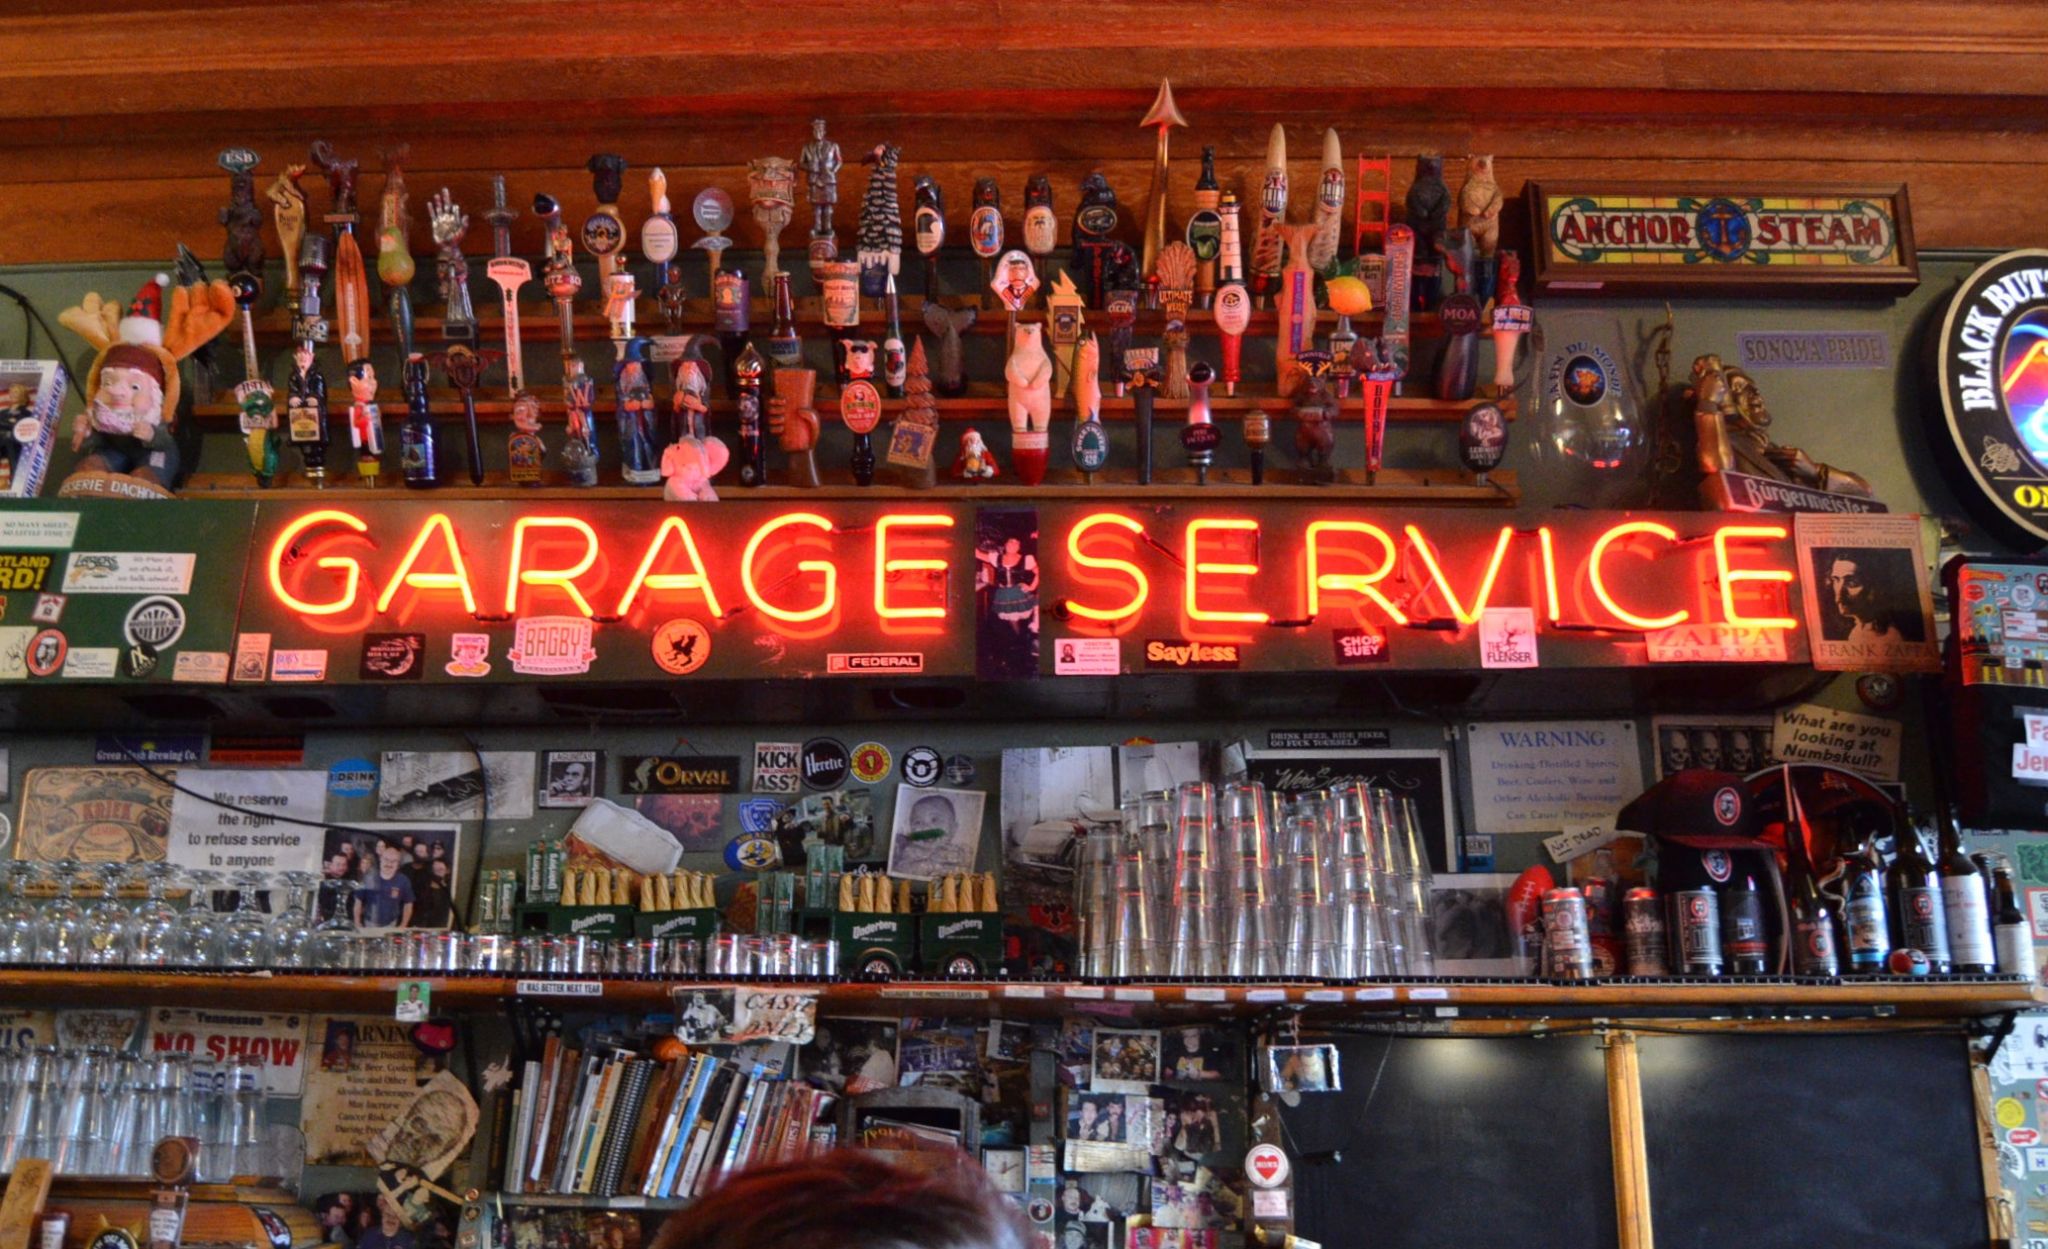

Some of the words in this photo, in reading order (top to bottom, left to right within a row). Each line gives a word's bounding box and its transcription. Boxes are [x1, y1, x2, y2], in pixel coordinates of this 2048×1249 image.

[225, 153, 253, 163] ESB
[1559, 213, 1692, 245] ANCHOR
[1756, 214, 1884, 246] STEAM
[1158, 290, 1193, 304] ULTIMATE
[1443, 309, 1478, 321] MOA
[1827, 338, 1884, 361] PRIDE
[1958, 305, 2003, 412] BLACK
[1981, 268, 2048, 317] BUT
[25, 449, 44, 497] HILLARY
[1744, 479, 1870, 513] Bürgermeister
[268, 509, 954, 622] GARAGE
[1066, 512, 1798, 629] SERVICE
[524, 627, 582, 658] BAGBY
[1340, 635, 1381, 646] CHOP
[1655, 626, 1776, 647] ZAPPA
[1146, 641, 1237, 663] Sayless
[1343, 645, 1379, 657] SUEY
[1487, 650, 1532, 663] FLENSER
[1818, 644, 1877, 658] FRANK
[851, 656, 918, 668] FEDERAL
[1781, 711, 1825, 730] What
[1829, 721, 1856, 733] are
[1858, 725, 1891, 740] you
[1500, 730, 1606, 747] WARNING
[1792, 730, 1855, 749] looking
[1859, 738, 1877, 750] at
[757, 751, 798, 768] KICK
[804, 752, 844, 777] Heretic
[1783, 744, 1884, 767] Numbskull?
[338, 772, 376, 781] DRINK
[655, 761, 731, 786] ORVAL
[754, 774, 799, 791] ASS?
[213, 791, 235, 806] We
[237, 794, 289, 806] reserve
[82, 801, 133, 821] KRIEK
[217, 812, 241, 827] the
[243, 812, 276, 830] right
[188, 832, 202, 846] to
[205, 832, 249, 847] refuse
[251, 833, 301, 847] service
[1575, 826, 1601, 845] DEAD
[209, 853, 223, 867] to
[226, 855, 276, 870] anyone
[571, 912, 616, 932] Underberg
[652, 916, 697, 937] Underberg
[852, 920, 898, 940] Underberg
[938, 918, 984, 939] Underberg
[527, 983, 540, 992] WAS
[541, 983, 565, 992] BETTER
[567, 984, 582, 993] NEXT
[584, 984, 600, 993] YEAR
[744, 991, 814, 1010] CASH
[196, 1012, 264, 1026] Tennessee
[354, 1024, 411, 1042] ARNIN
[153, 1032, 195, 1056] NO
[207, 1034, 300, 1067] SHOW
